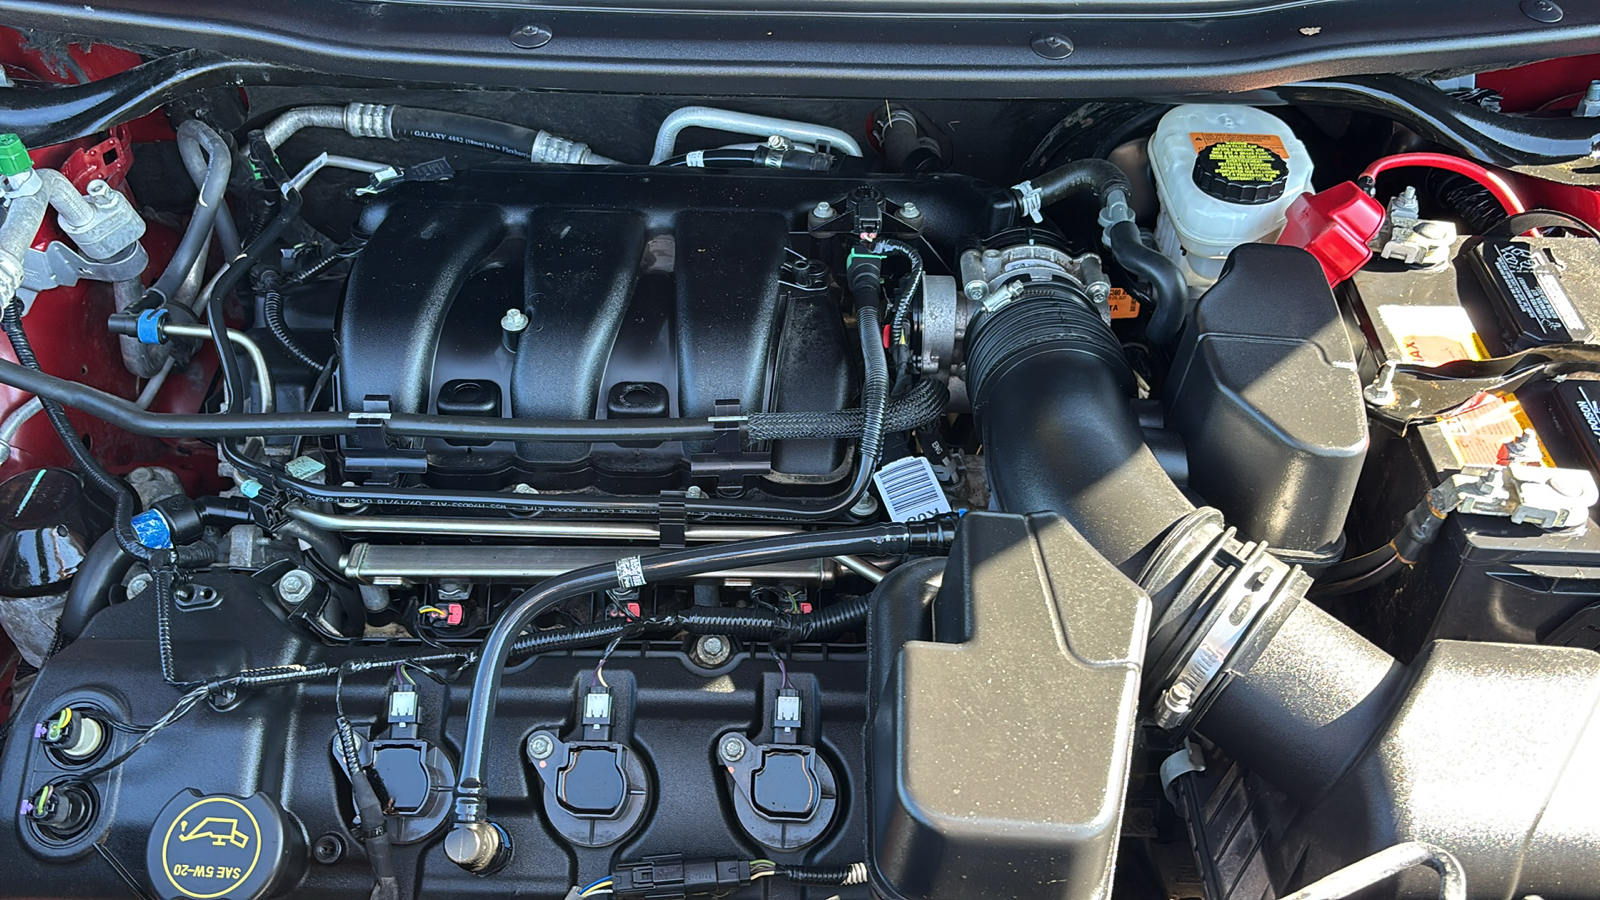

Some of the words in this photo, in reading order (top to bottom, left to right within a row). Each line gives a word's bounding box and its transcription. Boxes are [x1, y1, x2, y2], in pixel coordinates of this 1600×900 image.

[414, 130, 447, 140] GALAXY
[1404, 341, 1424, 362] AX
[931, 440, 944, 455] ENG
[173, 864, 215, 878] 5W-20
[216, 866, 241, 879] SAE
